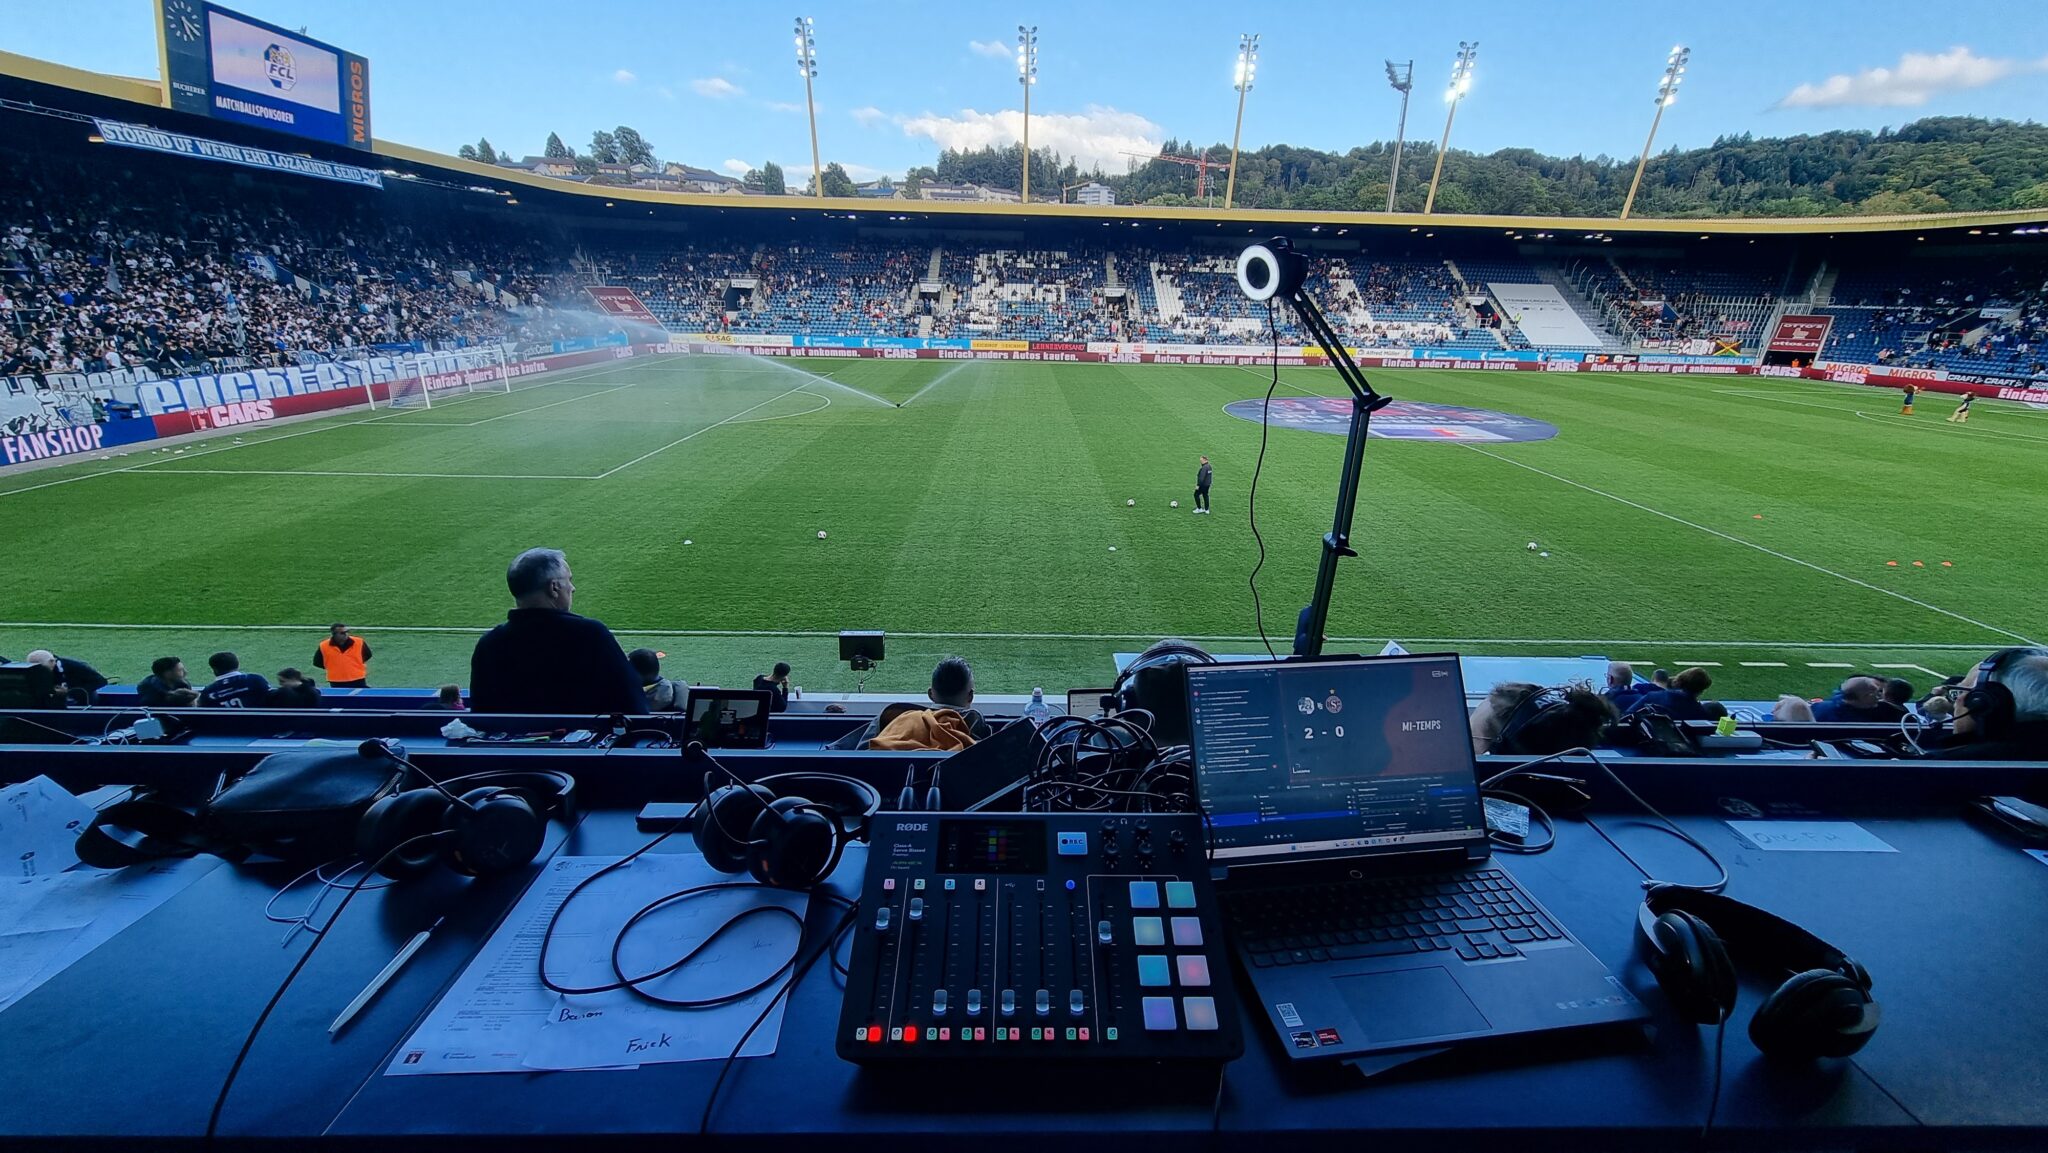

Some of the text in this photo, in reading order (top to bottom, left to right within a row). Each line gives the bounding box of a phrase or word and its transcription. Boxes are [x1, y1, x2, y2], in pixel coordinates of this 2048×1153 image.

[269, 64, 294, 80] FCL
[352, 62, 364, 142] MIGROS
[216, 96, 294, 124] MATCHBALLSPONSOREN
[171, 137, 194, 153] UF
[195, 141, 244, 161] WENN
[242, 149, 273, 166] EHR
[656, 343, 690, 354] CARS
[753, 345, 787, 356] überall
[790, 347, 805, 357] gut
[808, 348, 861, 357] ankommen.
[884, 348, 917, 358] CARS
[938, 350, 1079, 361] Einfach anders Autos kaufen.
[1108, 353, 1141, 363] CARS
[1154, 354, 1184, 365] Autos,
[1187, 355, 1200, 363] die
[1203, 355, 1236, 364] überall
[1238, 356, 1253, 366] gut
[1382, 357, 1518, 370] Einfach anders Autos kaufen.
[1546, 362, 1579, 372] CARS
[1590, 362, 1738, 374] Autos, die überall gut ankommen.
[1760, 365, 1802, 377] CARS
[1825, 362, 1936, 380] MIGROS MIGROS
[1832, 371, 1867, 384] CARS
[425, 373, 463, 391] Einfach
[1948, 374, 2017, 387] CRAFT CRAFT
[1998, 388, 2048, 403] Einfach
[212, 399, 275, 428] CARS
[2, 424, 104, 464] FANSHOP
[1304, 727, 1314, 739] 2
[1335, 726, 1345, 737] 0
[1402, 720, 1441, 732] MI-TEMPS
[896, 823, 928, 831] RØDE
